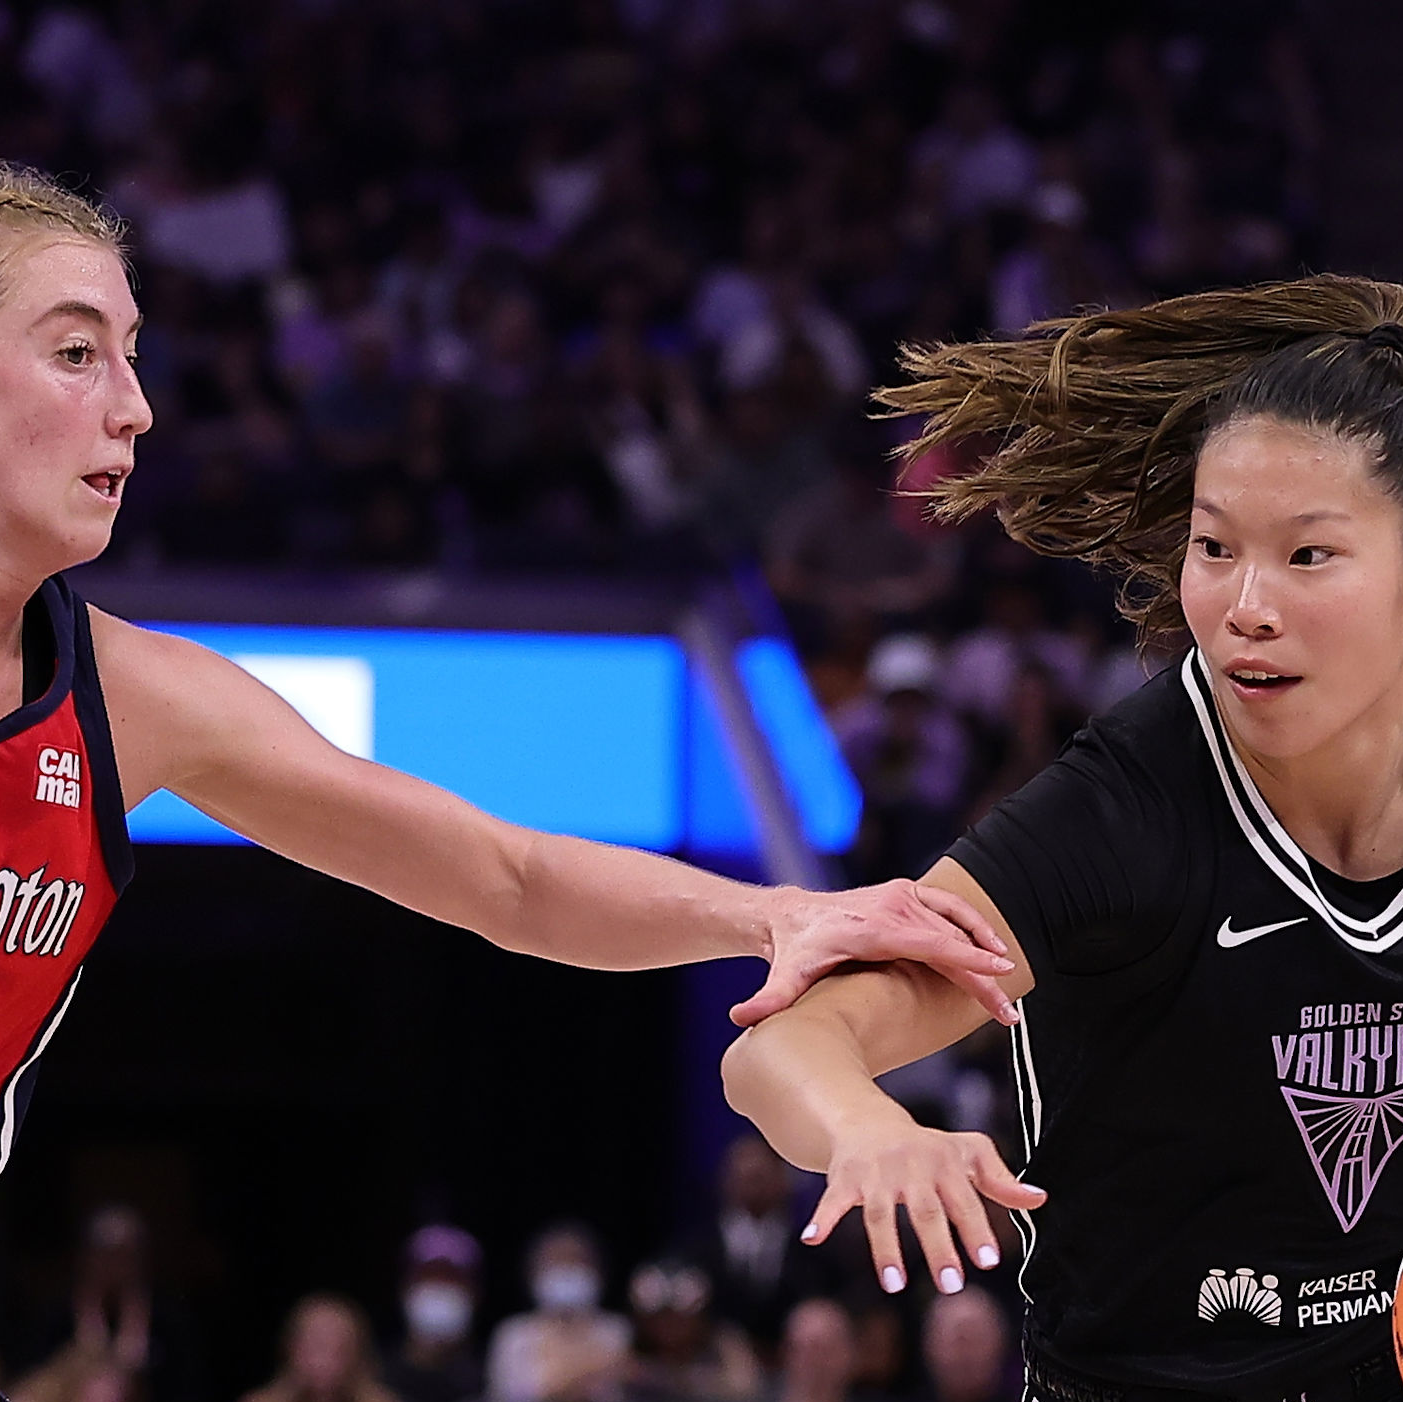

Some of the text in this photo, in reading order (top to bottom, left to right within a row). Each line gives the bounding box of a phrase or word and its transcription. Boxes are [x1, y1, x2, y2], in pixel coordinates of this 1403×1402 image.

[35, 774, 80, 809] ma
[1299, 1001, 1382, 1029] GOLDEN
[1298, 1269, 1376, 1298] KAISER
